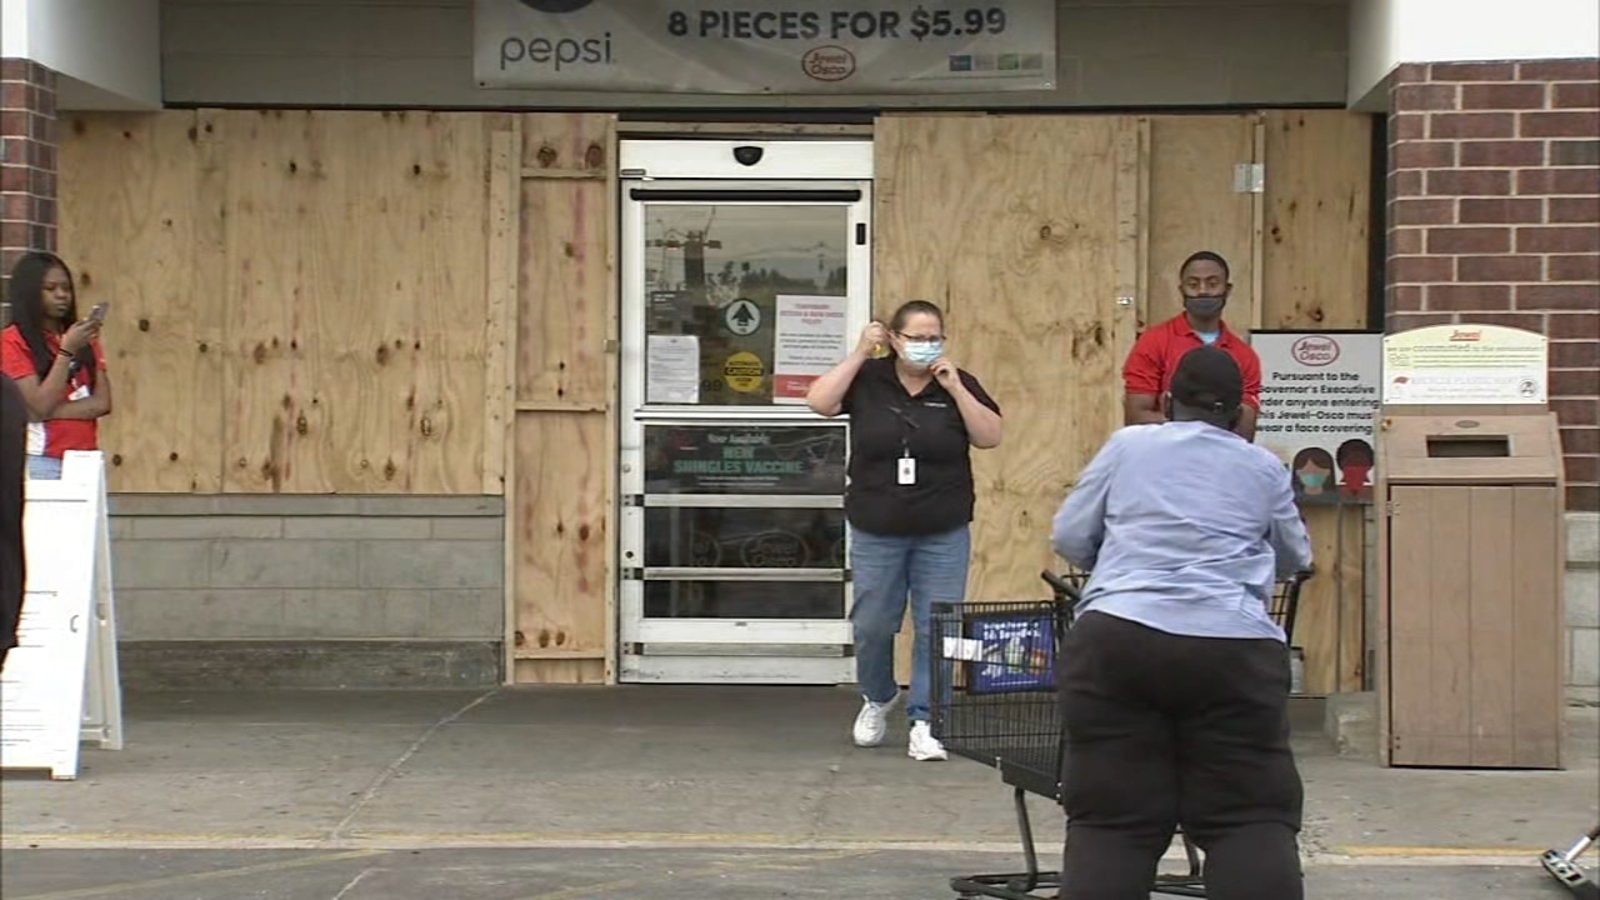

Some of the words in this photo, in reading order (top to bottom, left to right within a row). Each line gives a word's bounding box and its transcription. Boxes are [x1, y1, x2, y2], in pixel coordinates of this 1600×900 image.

[668, 10, 688, 36] 8
[699, 10, 820, 39] PIECES
[830, 10, 901, 38] FOR
[910, 5, 1006, 41] $5.99
[500, 31, 610, 71] pepsi
[811, 65, 846, 75] Osco
[1298, 341, 1332, 351] Jewel
[1299, 351, 1332, 361] Osco
[1272, 372, 1325, 381] Pursuant
[1326, 372, 1338, 381] to
[1340, 372, 1359, 381] the
[1321, 384, 1375, 394] Executive
[1260, 398, 1284, 406] rder
[1285, 399, 1328, 409] anyone
[1331, 398, 1380, 409] entering
[1259, 410, 1275, 420] his
[1278, 410, 1346, 420] Jewel-Osco
[1347, 411, 1373, 420] mus
[1284, 424, 1293, 433] a
[1295, 423, 1321, 433] face
[1322, 424, 1373, 436] covering
[723, 446, 755, 459] NEW
[673, 461, 741, 474] SHINGLES
[744, 461, 804, 474] VACCINE
